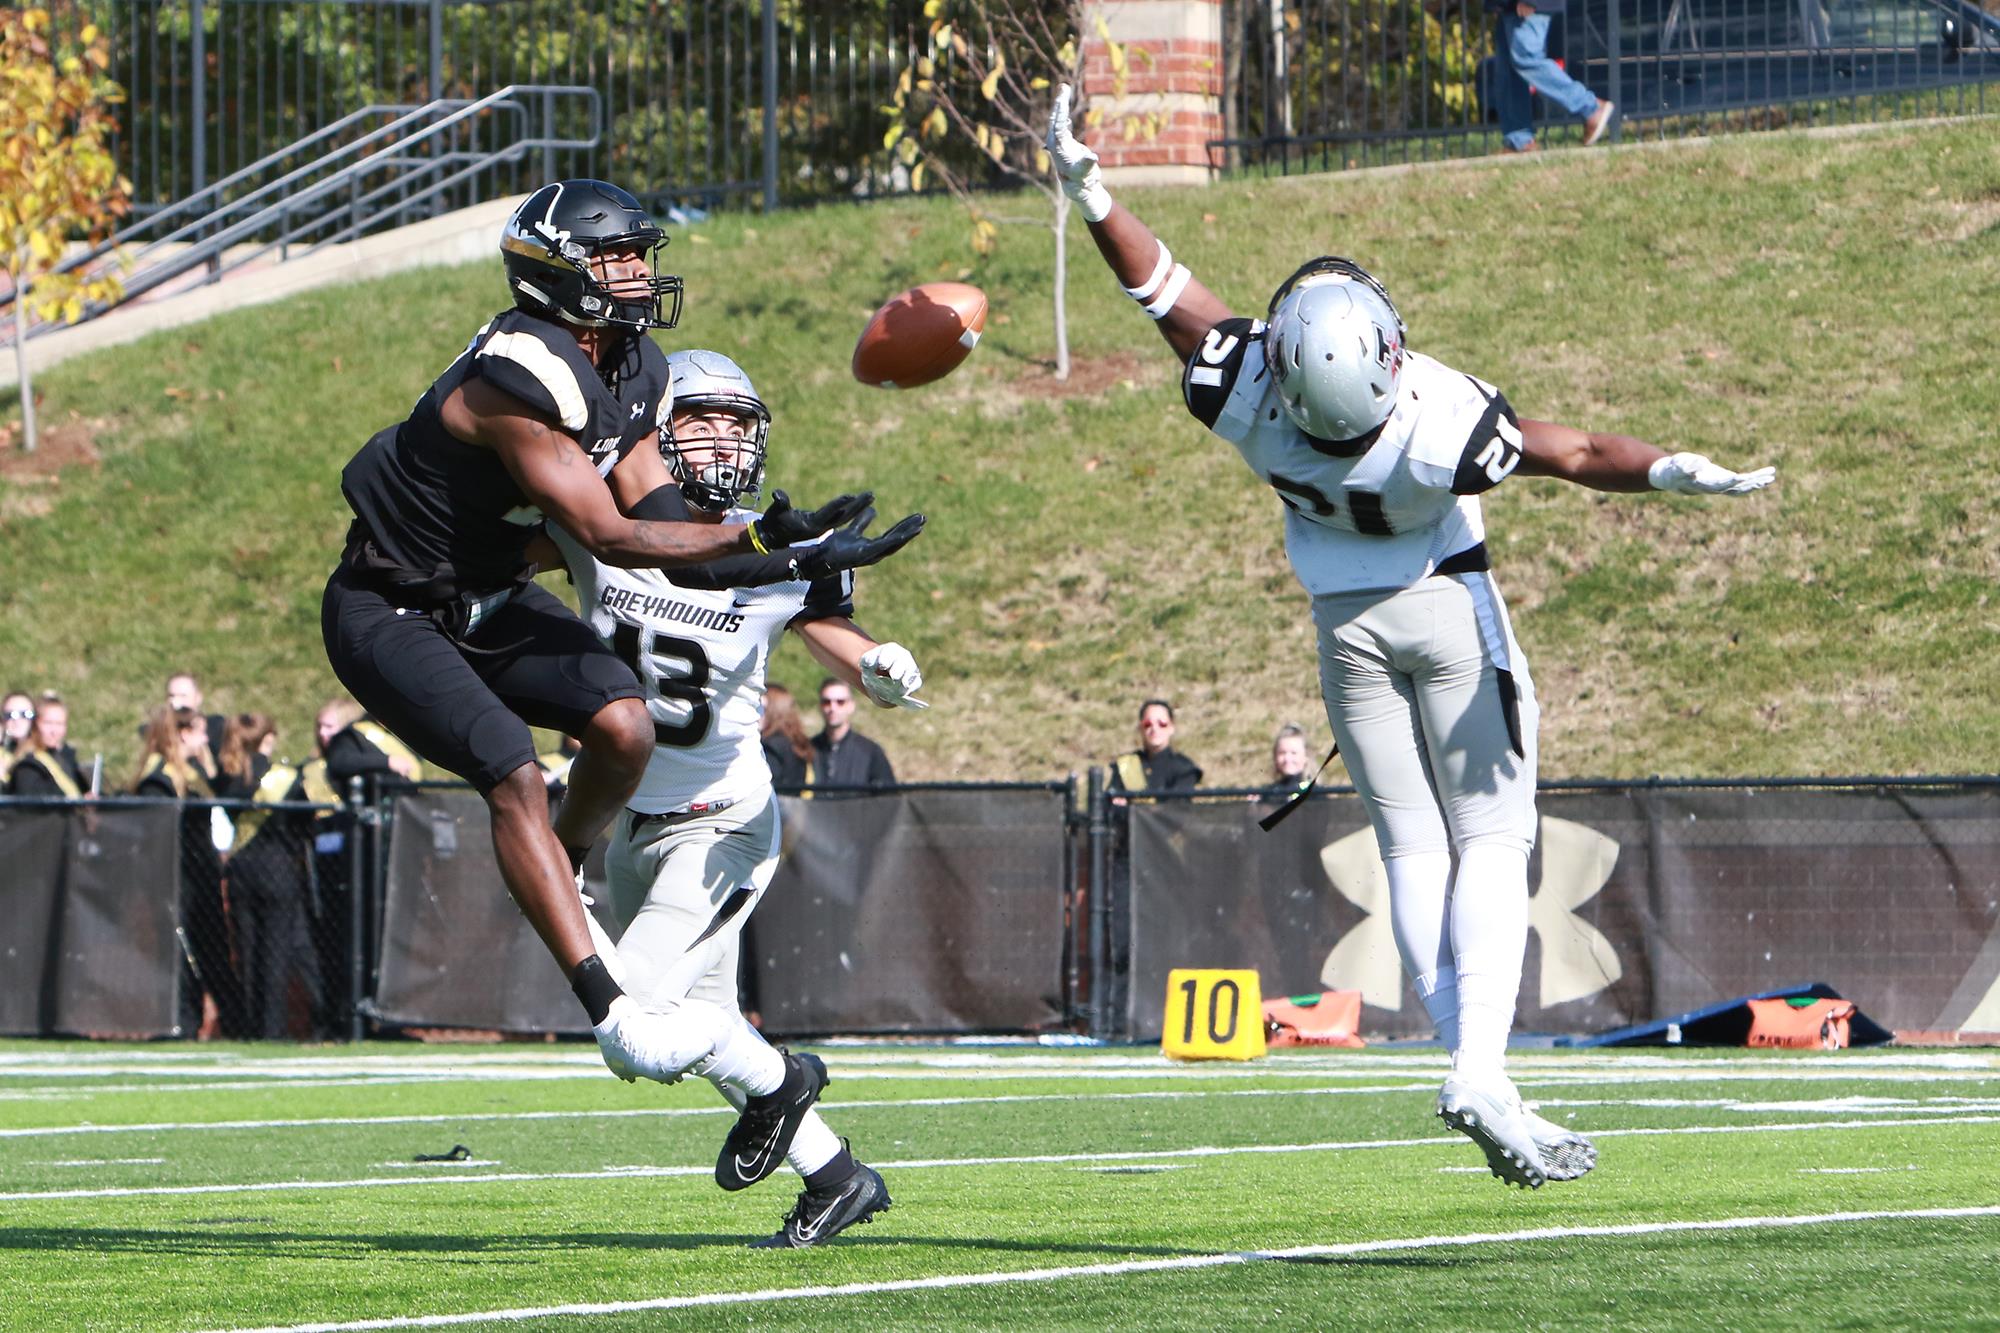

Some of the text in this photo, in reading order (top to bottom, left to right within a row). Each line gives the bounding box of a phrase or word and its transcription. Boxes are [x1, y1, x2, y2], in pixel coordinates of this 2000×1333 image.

[1473, 412, 1523, 484] 21
[601, 584, 745, 634] GREYHOUNDS
[1181, 979, 1240, 1045] 10
